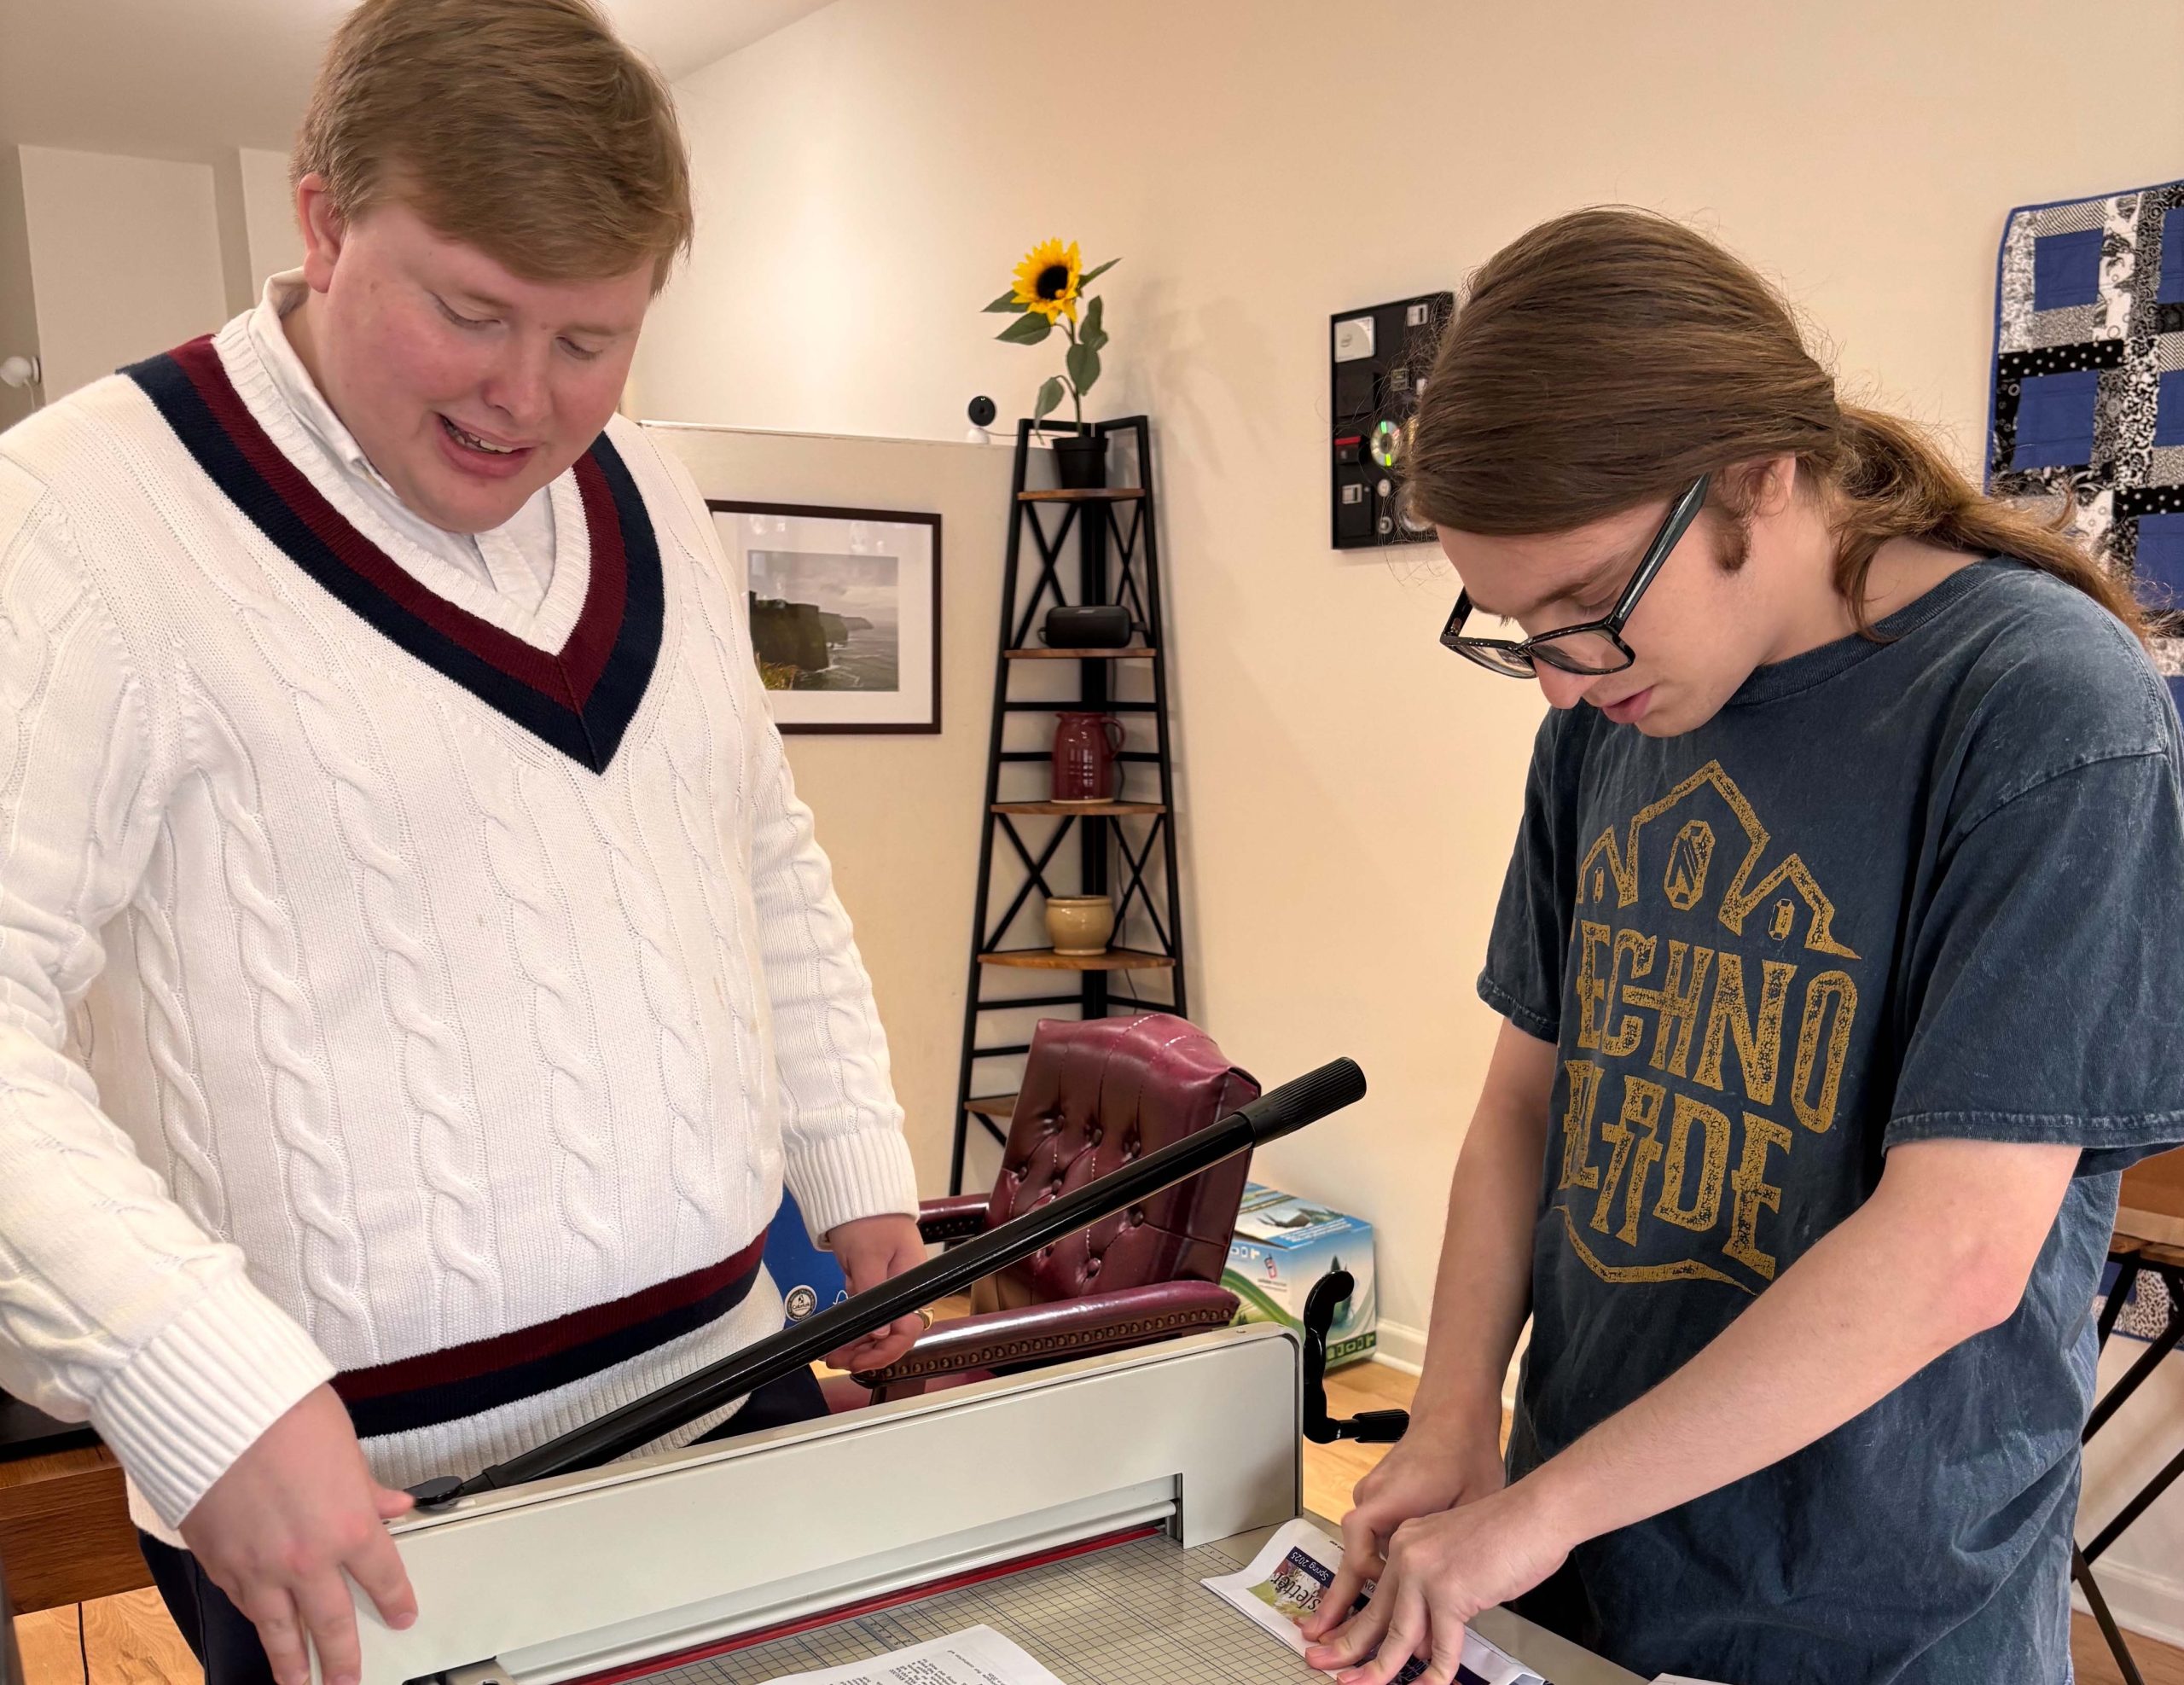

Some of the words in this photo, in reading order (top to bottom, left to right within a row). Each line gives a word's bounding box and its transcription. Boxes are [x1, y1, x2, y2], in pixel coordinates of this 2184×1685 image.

[1571, 919, 1858, 1134] ECHNO
[1290, 1551, 1310, 1567] 2025
[1309, 1561, 1329, 1581] Spring
[1270, 1572, 1321, 1612] sletter
